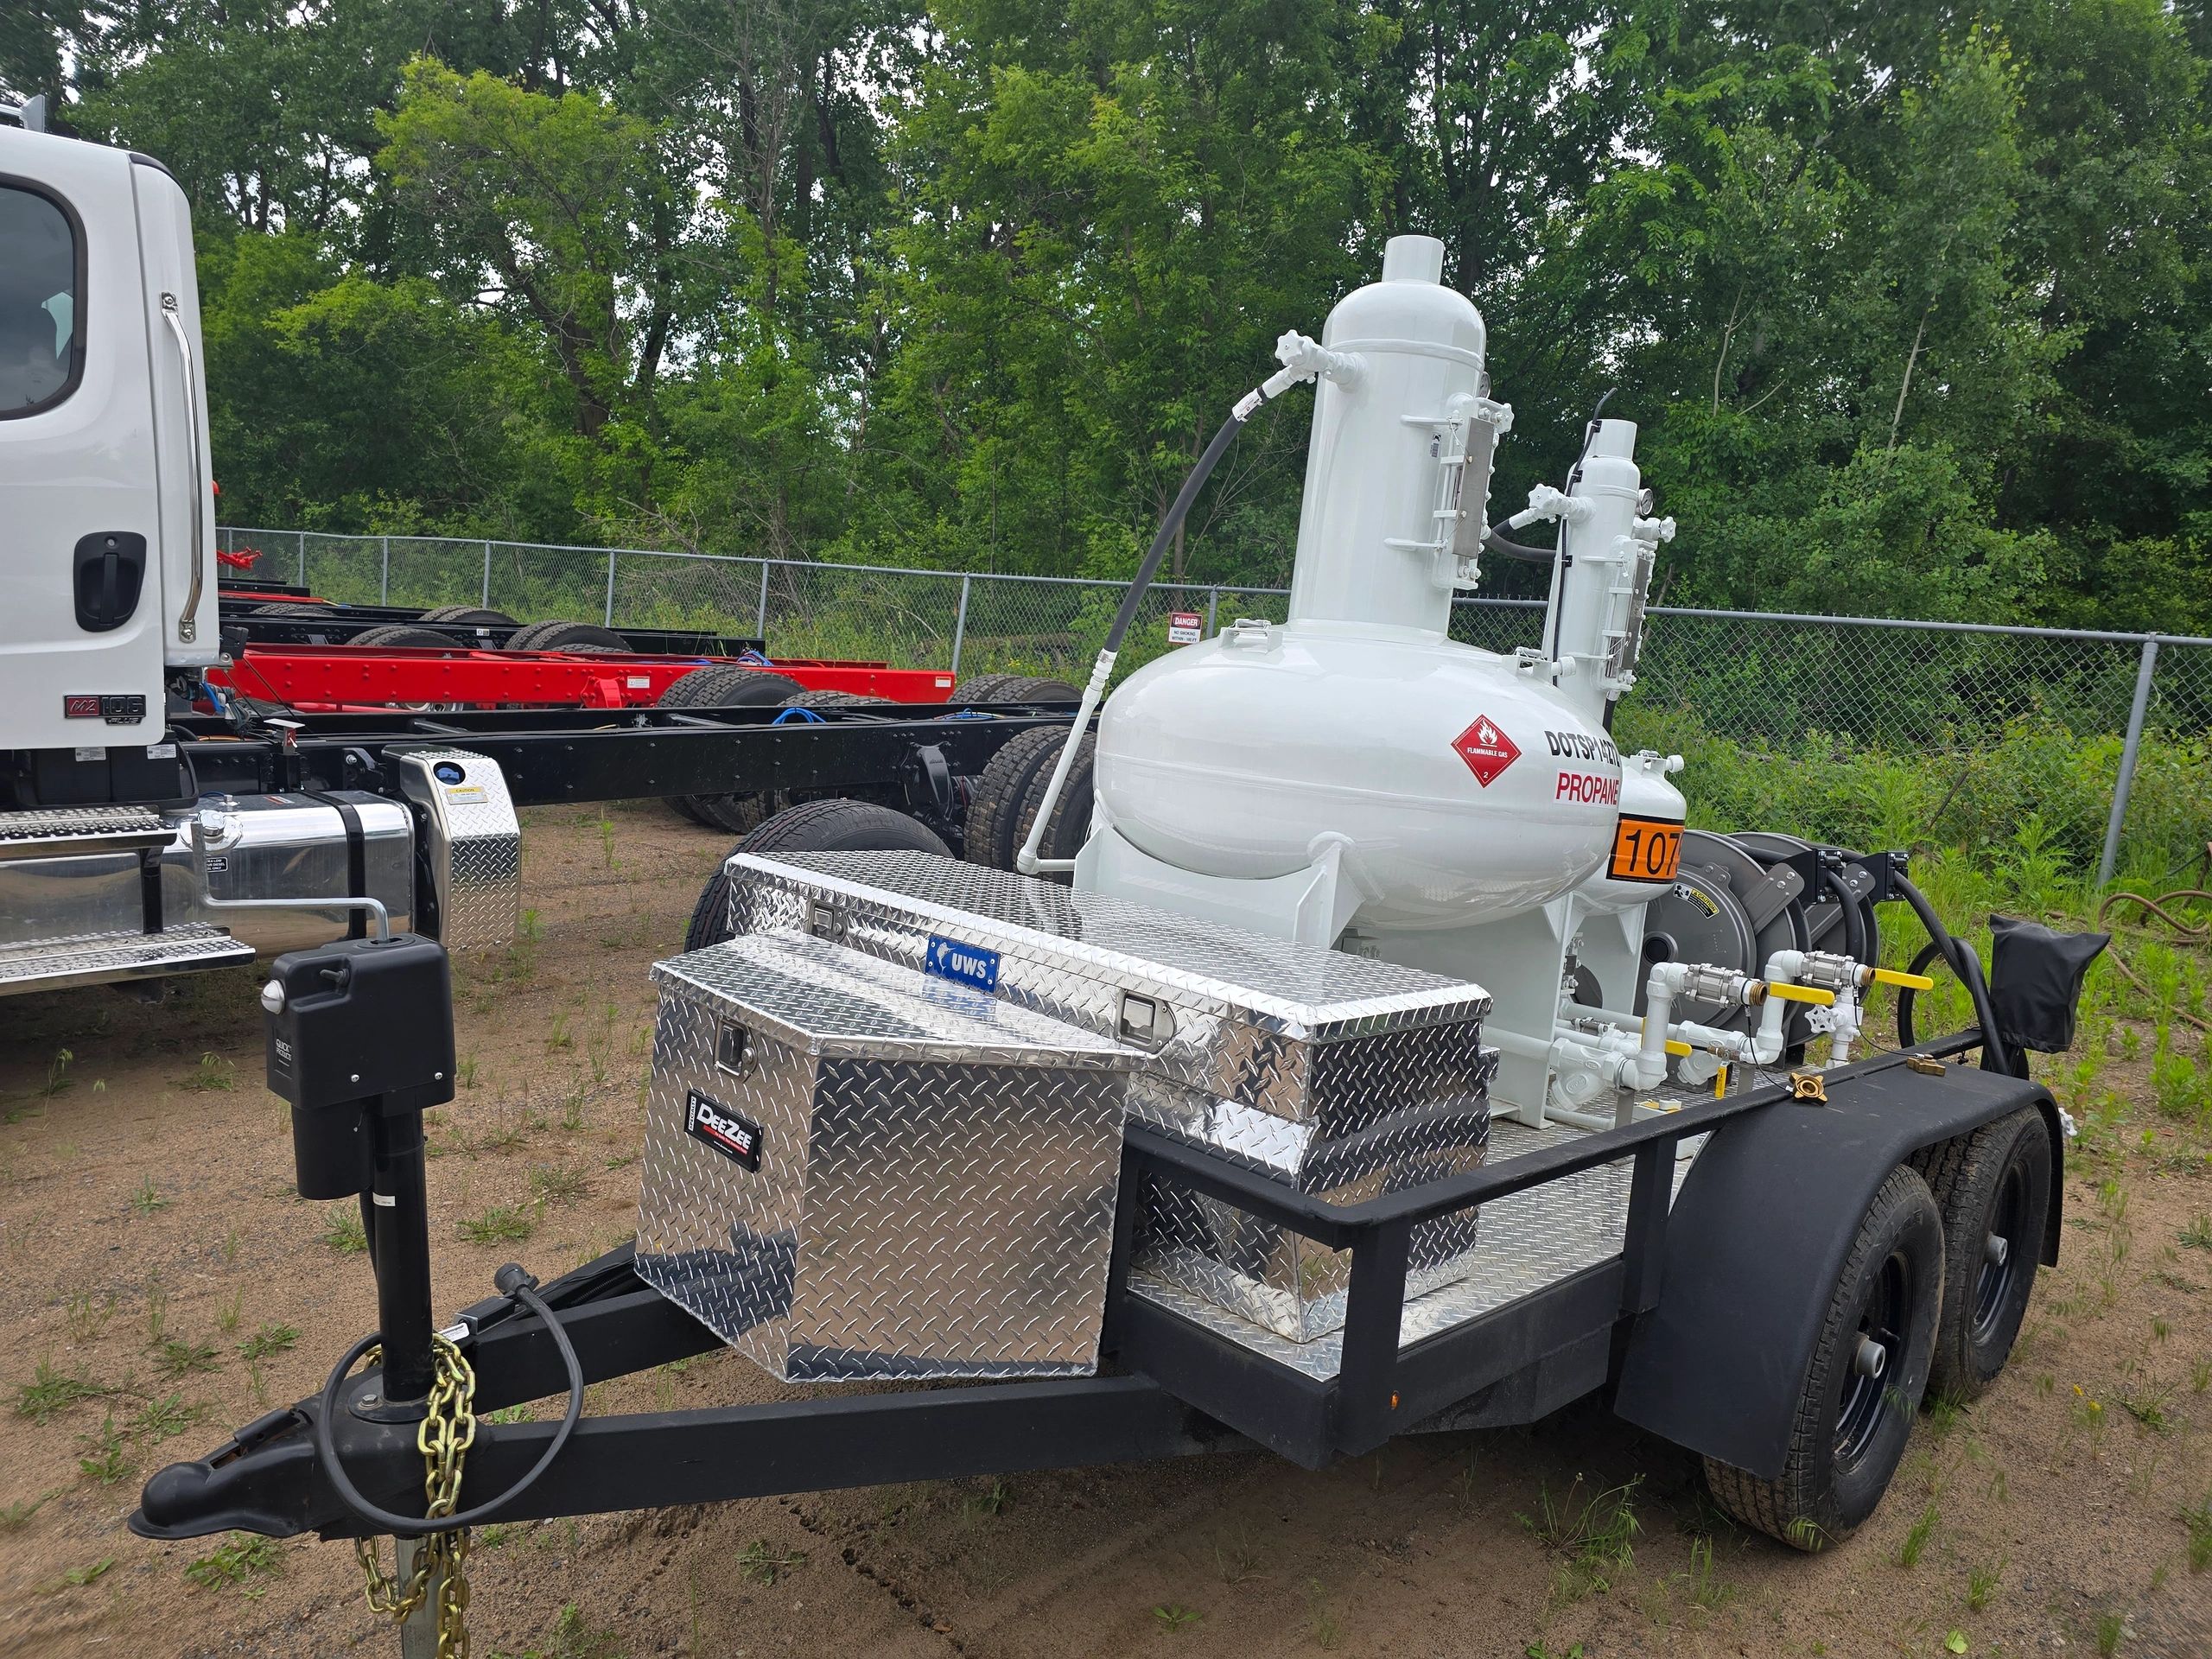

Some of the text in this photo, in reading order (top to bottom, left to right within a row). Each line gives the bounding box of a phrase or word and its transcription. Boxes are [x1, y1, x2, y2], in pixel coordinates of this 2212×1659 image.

[1174, 617, 1198, 626] DANGER
[70, 696, 143, 715] M2 106
[1467, 747, 1497, 757] FLAMMABLE
[1555, 772, 1619, 805] PROPANE
[1625, 829, 1682, 877] 107
[1697, 893, 1717, 912] CAUTION
[951, 953, 987, 979] UWS
